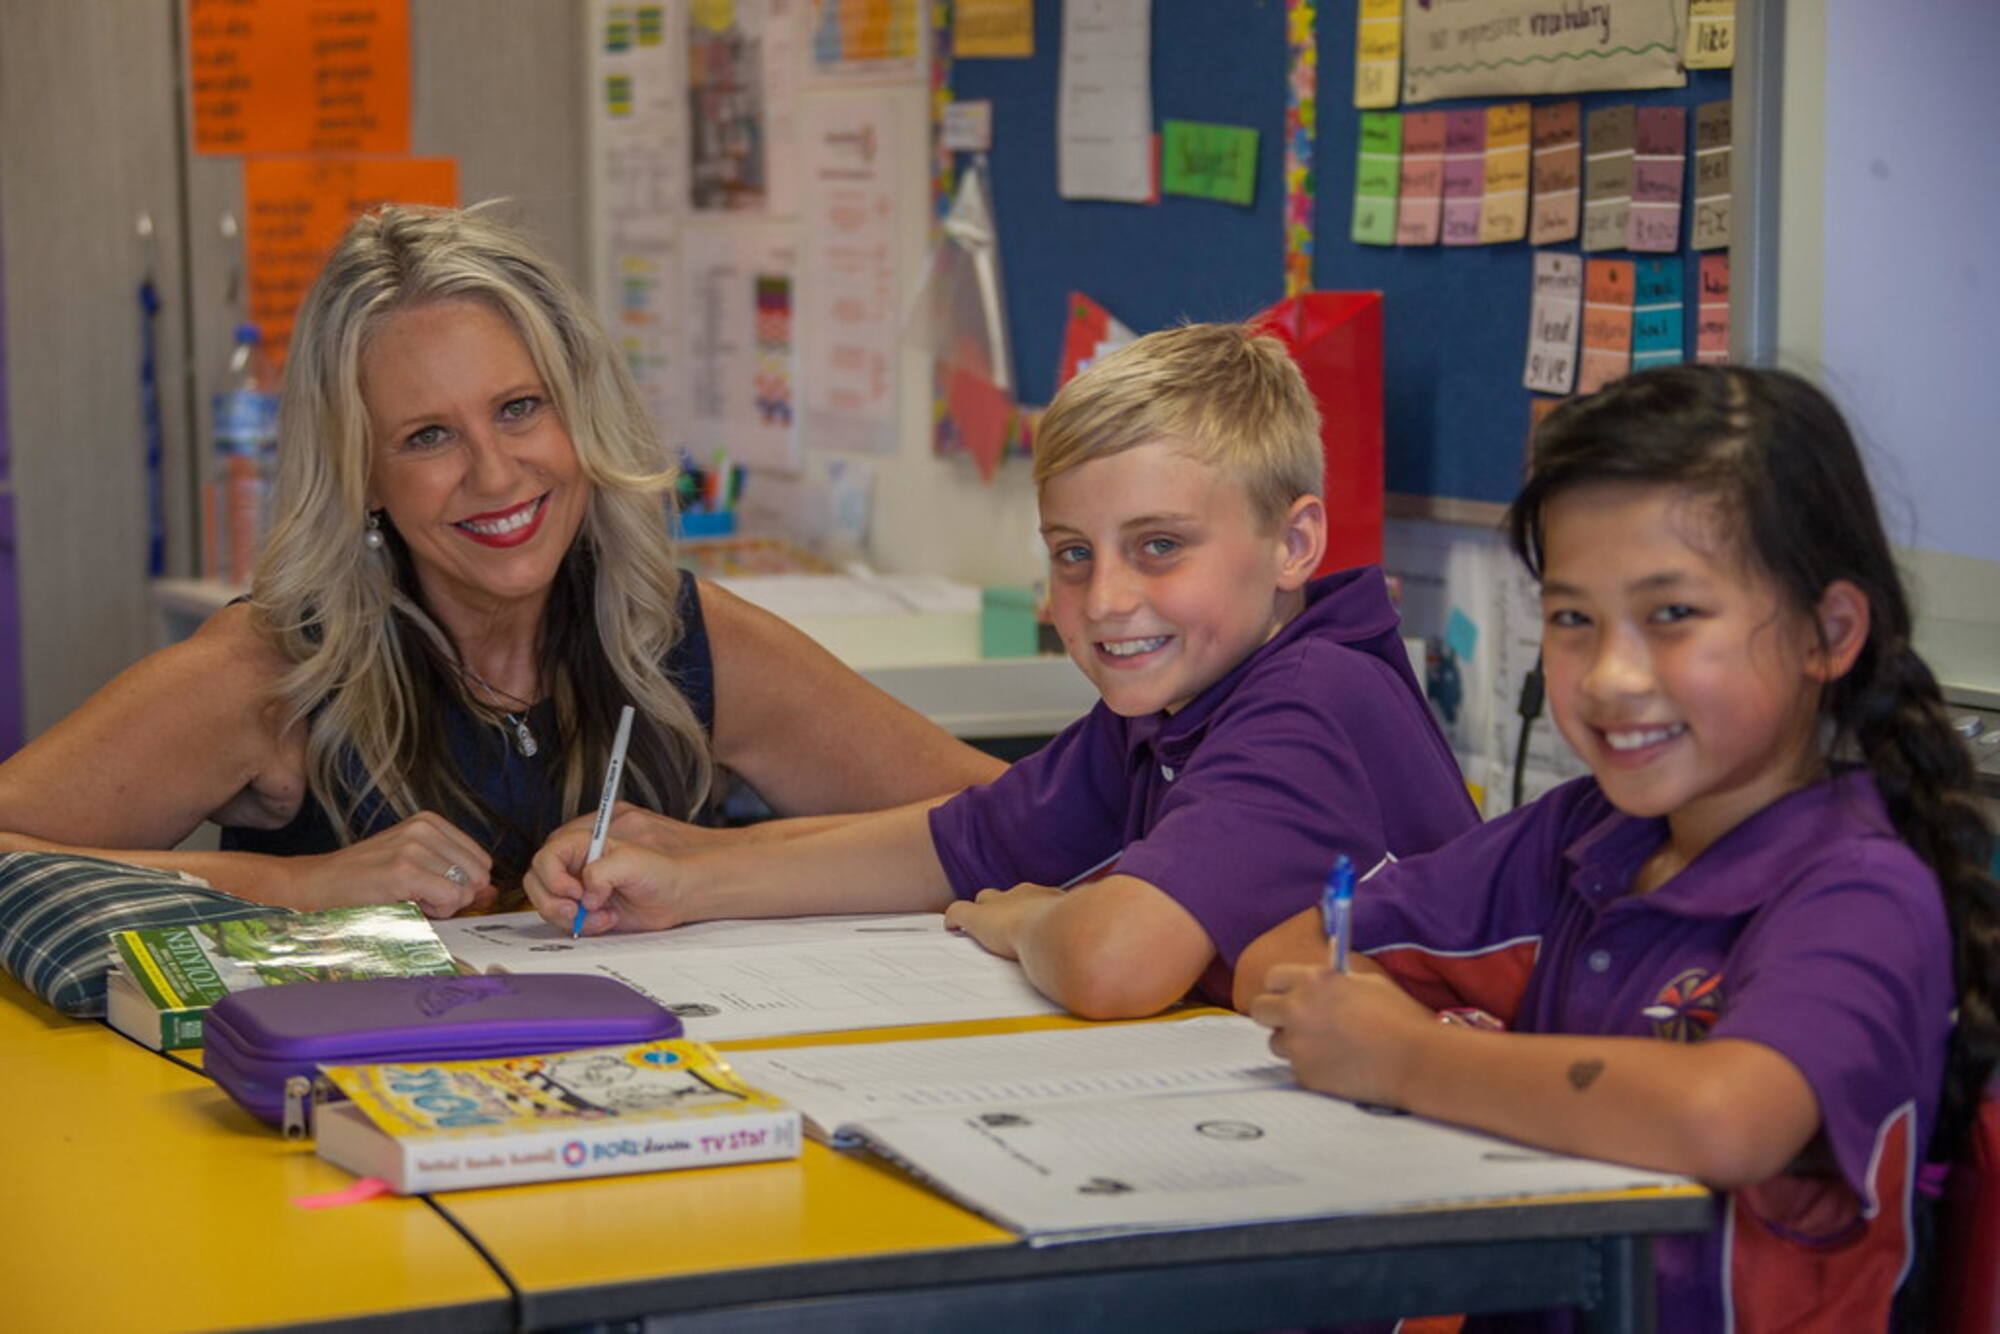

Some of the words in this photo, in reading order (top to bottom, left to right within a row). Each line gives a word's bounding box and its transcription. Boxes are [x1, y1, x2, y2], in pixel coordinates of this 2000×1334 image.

[1529, 2, 1610, 45] vocabulary
[1697, 22, 1730, 53] like
[1529, 354, 1568, 385] give
[161, 930, 222, 991] TOLKIEN
[699, 1135, 726, 1153] TV
